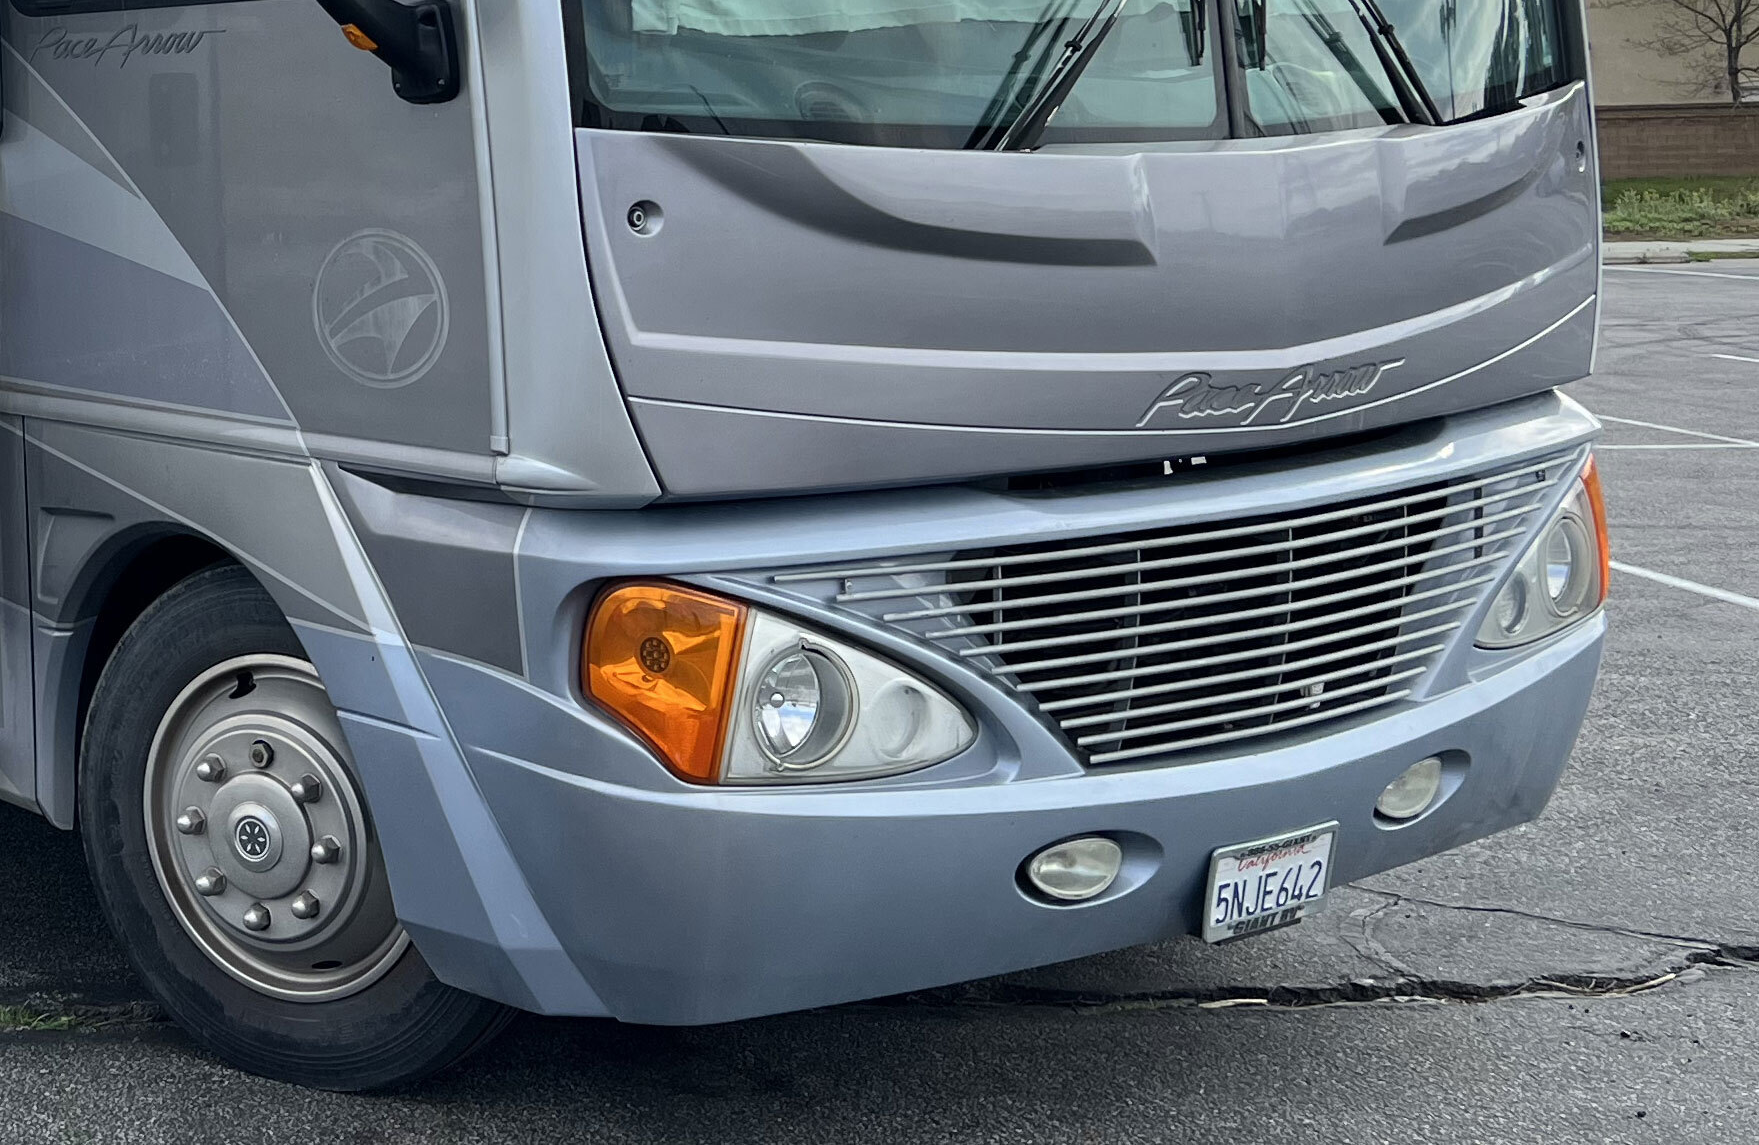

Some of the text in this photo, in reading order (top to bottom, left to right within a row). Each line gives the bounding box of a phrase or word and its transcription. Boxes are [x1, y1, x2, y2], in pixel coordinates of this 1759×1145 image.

[28, 22, 227, 69] Pace Arrow
[1237, 843, 1311, 872] California
[1215, 860, 1323, 924] 5NJE642
[1233, 911, 1279, 935] GIANT
